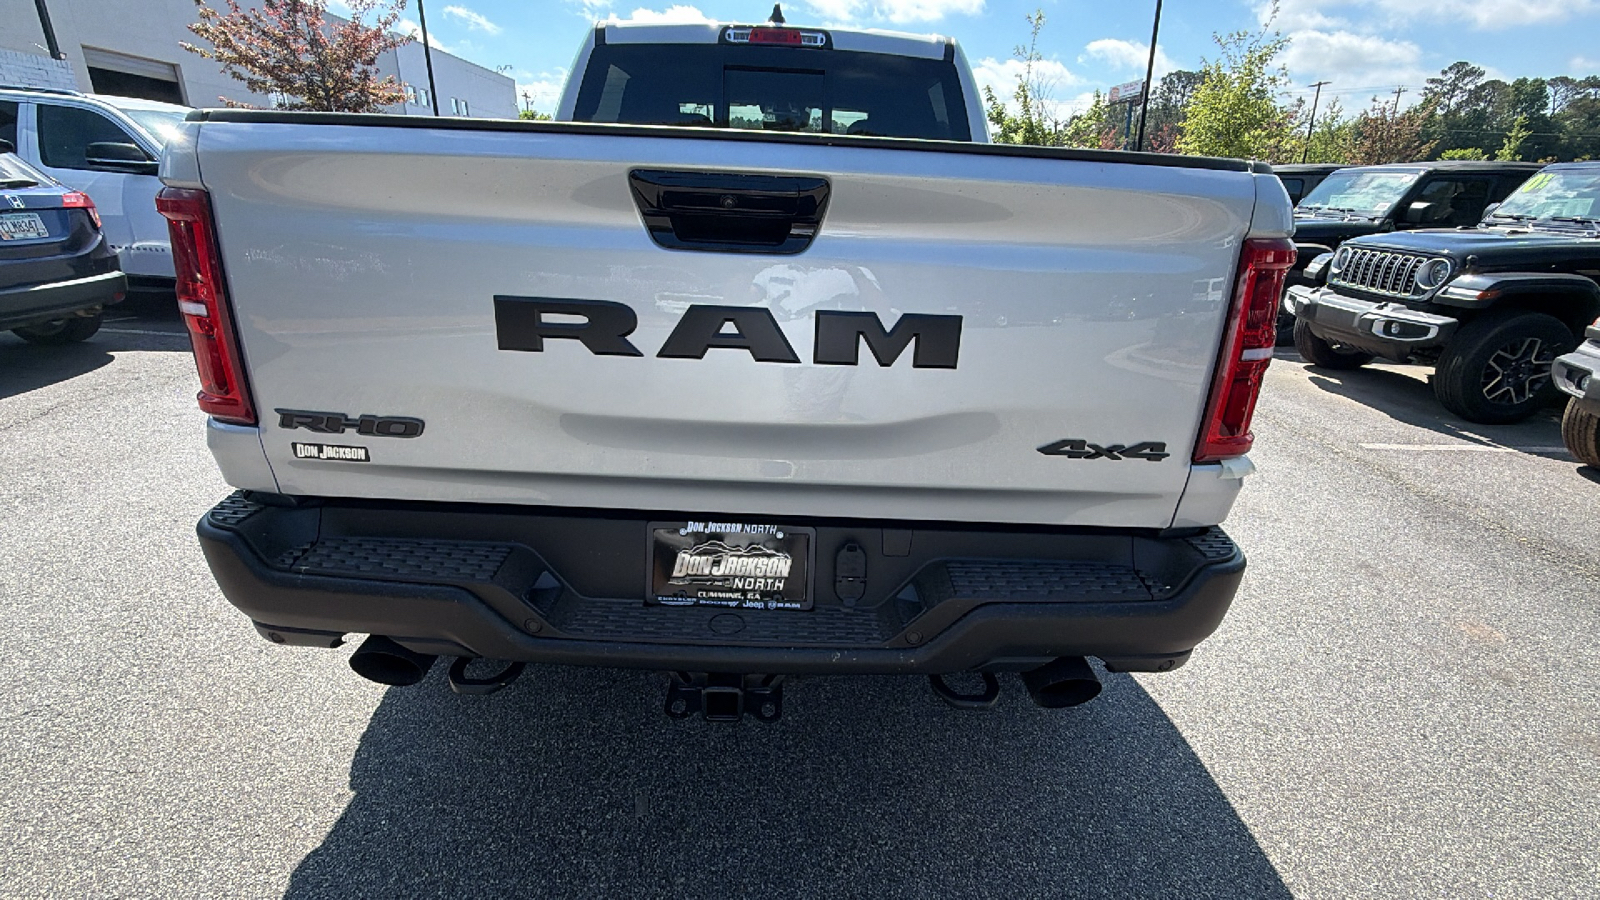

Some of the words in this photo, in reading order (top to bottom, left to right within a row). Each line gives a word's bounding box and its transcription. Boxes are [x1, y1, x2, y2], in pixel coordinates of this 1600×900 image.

[493, 295, 963, 369] RAM
[274, 408, 425, 438] RHO
[743, 525, 778, 535] NORTH
[733, 578, 785, 590] NORTH
[697, 591, 744, 600] CUMMING,
[747, 592, 761, 600] GA
[743, 600, 765, 609] Jeep
